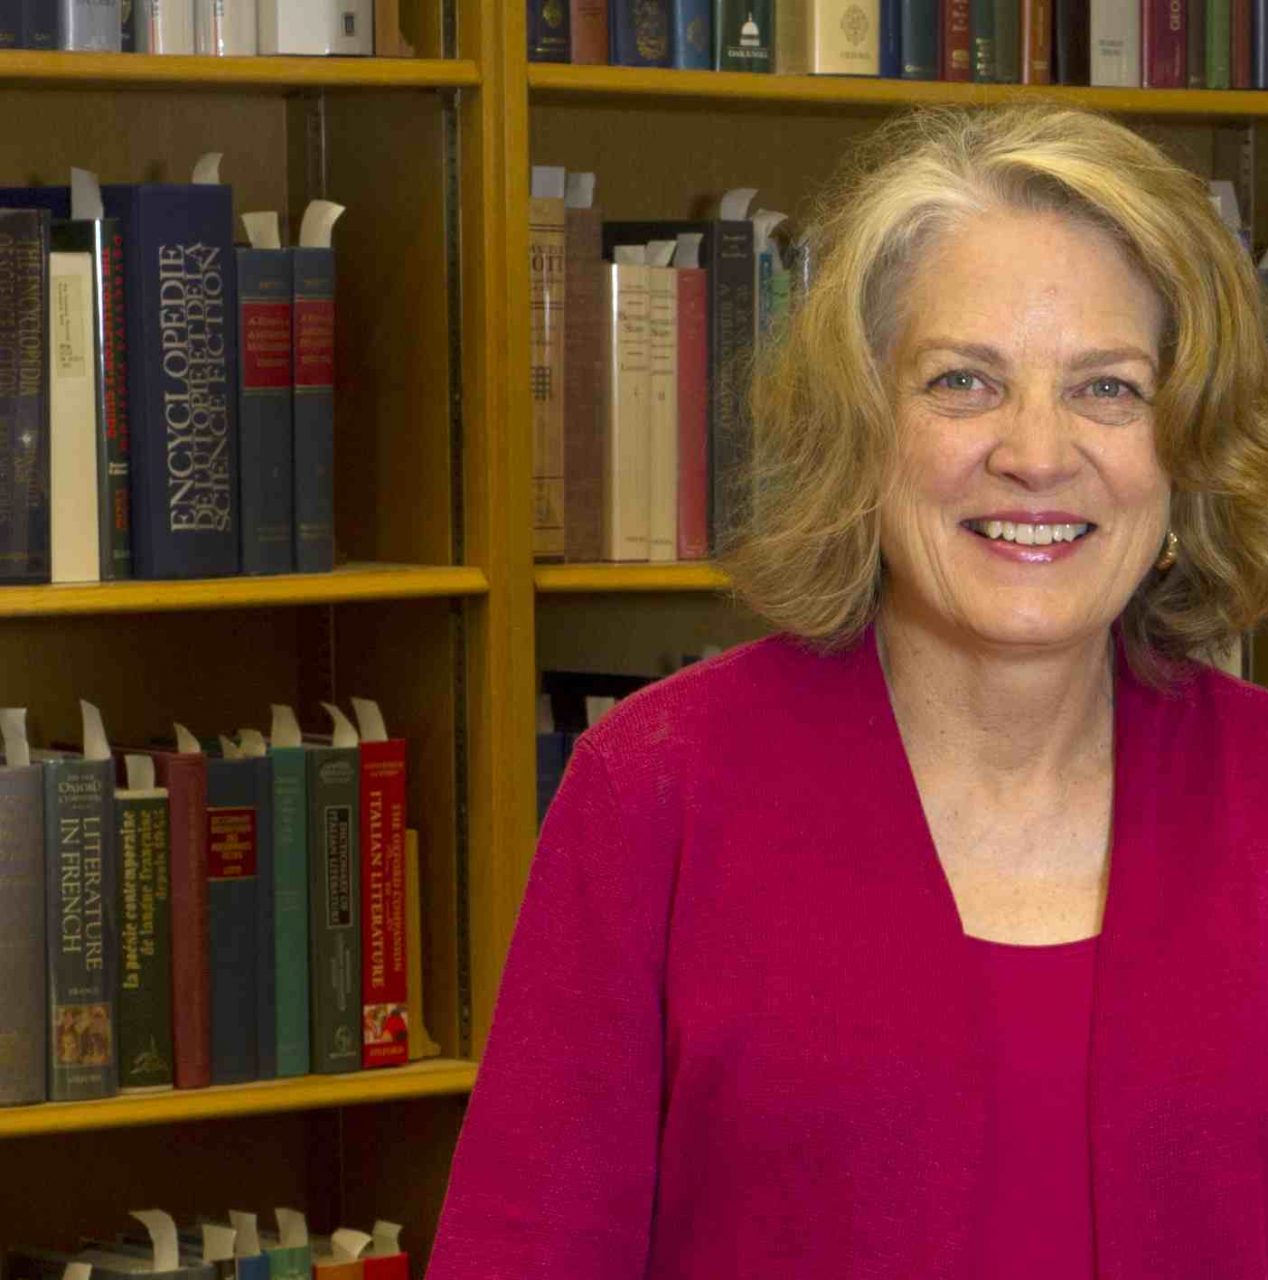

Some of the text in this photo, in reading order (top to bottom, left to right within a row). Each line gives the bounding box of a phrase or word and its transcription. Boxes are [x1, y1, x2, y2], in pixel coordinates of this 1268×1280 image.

[159, 244, 196, 532] ENCYCLOPEDIE
[202, 244, 231, 532] SCIENCE FICTION
[60, 817, 80, 844] IN
[60, 848, 82, 954] FRENCH
[82, 816, 104, 971] LITERATURE
[369, 791, 385, 989] ITALIAN LITERATURE
[122, 973, 140, 989] la
